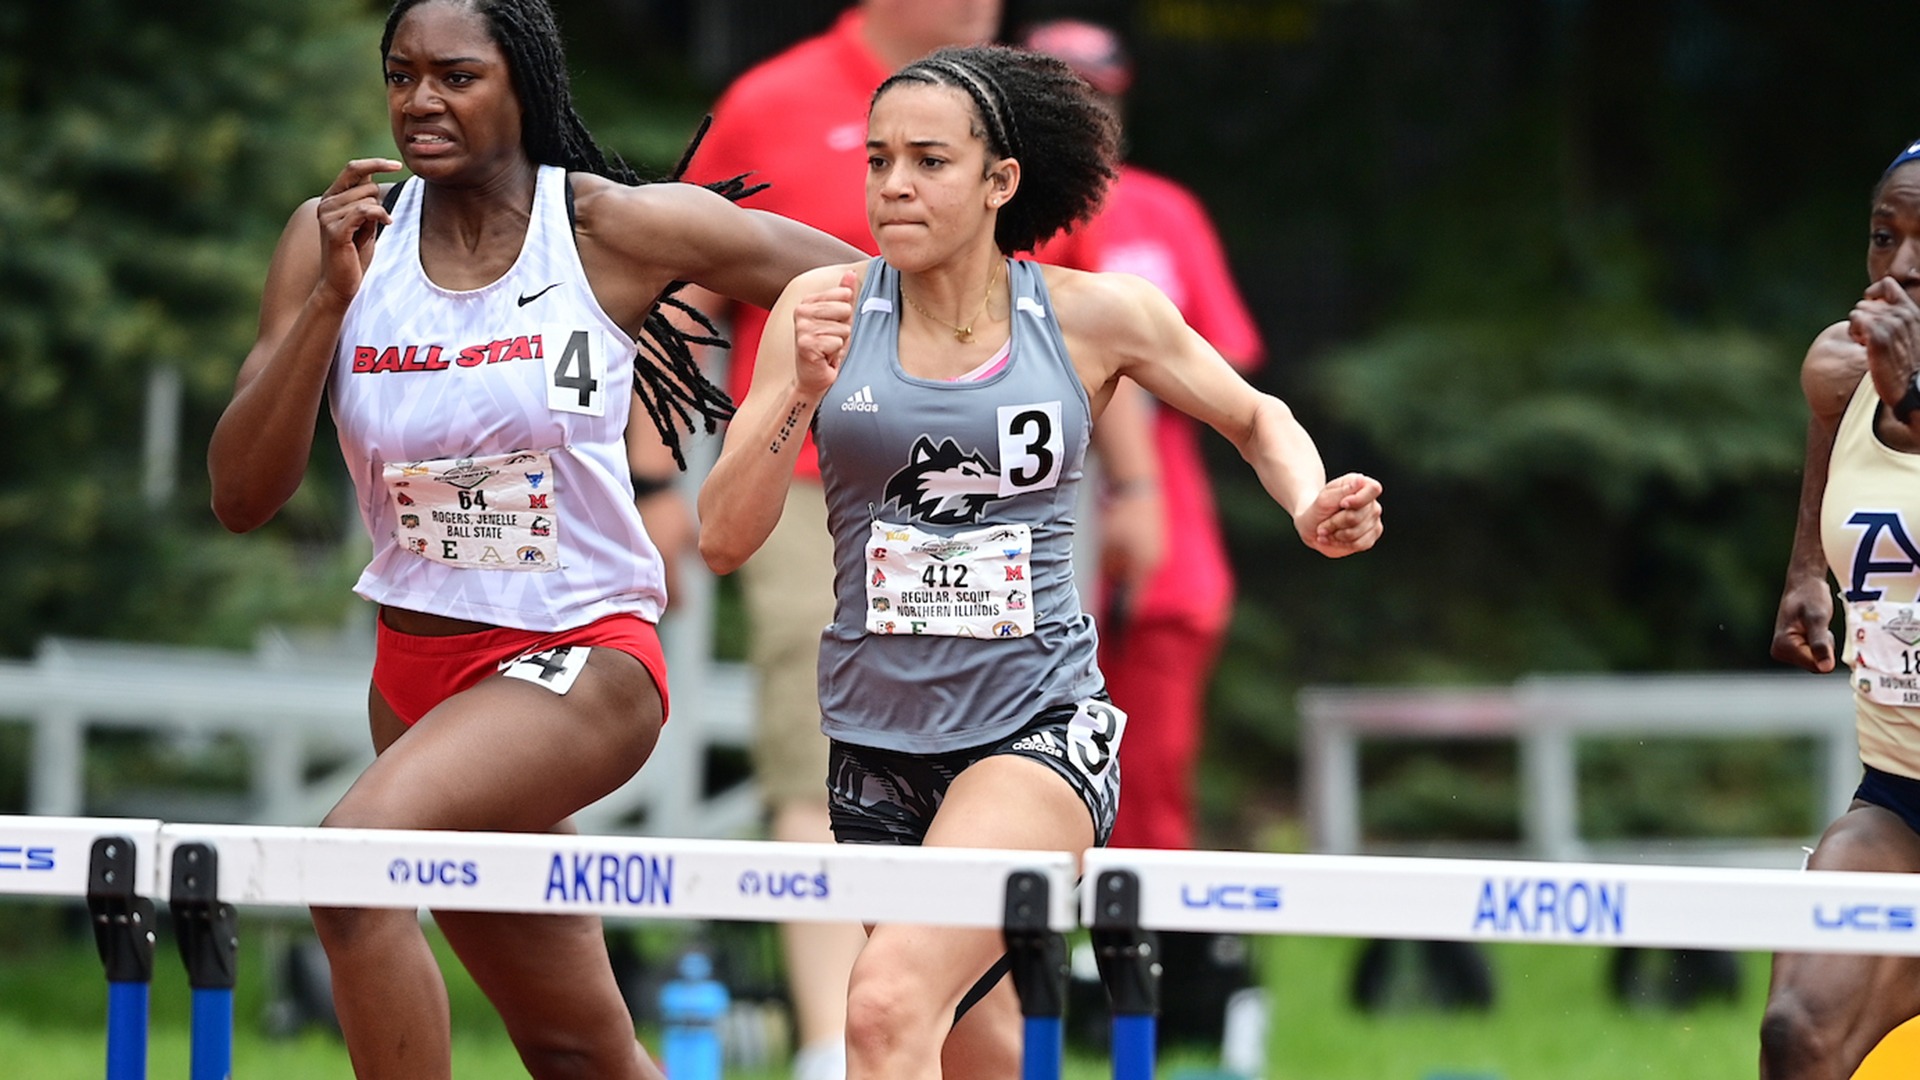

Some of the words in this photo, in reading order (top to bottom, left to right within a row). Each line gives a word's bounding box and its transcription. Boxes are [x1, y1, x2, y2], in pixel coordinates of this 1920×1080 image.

[352, 345, 450, 374] BALL
[456, 334, 543, 367] STAT
[554, 330, 597, 407] 4
[841, 401, 879, 413] adidas
[1009, 410, 1055, 487] 3
[458, 490, 488, 510] 64
[528, 494, 549, 508] M
[432, 511, 473, 525] ROGERS,
[476, 514, 517, 526] JENELLE
[447, 525, 471, 537] BALL
[474, 526, 502, 539] STATE
[441, 540, 458, 559] E
[479, 546, 504, 563] A
[1845, 512, 1920, 602] A
[922, 564, 968, 588] 412
[1005, 565, 1024, 581] M
[901, 591, 953, 603] REGULAR,
[957, 590, 990, 602] SCOUT
[897, 605, 951, 618] NORTHERN
[954, 604, 1000, 616] ILLINOIS
[1012, 741, 1063, 758] adidas
[1075, 704, 1117, 776] 3
[0, 847, 54, 870] CS
[416, 861, 478, 886] UCS
[545, 853, 674, 905] AKRON
[766, 873, 829, 898] UCS
[1180, 885, 1282, 910] UCS
[1473, 878, 1627, 935] AKRON
[1813, 905, 1916, 930] UCS
